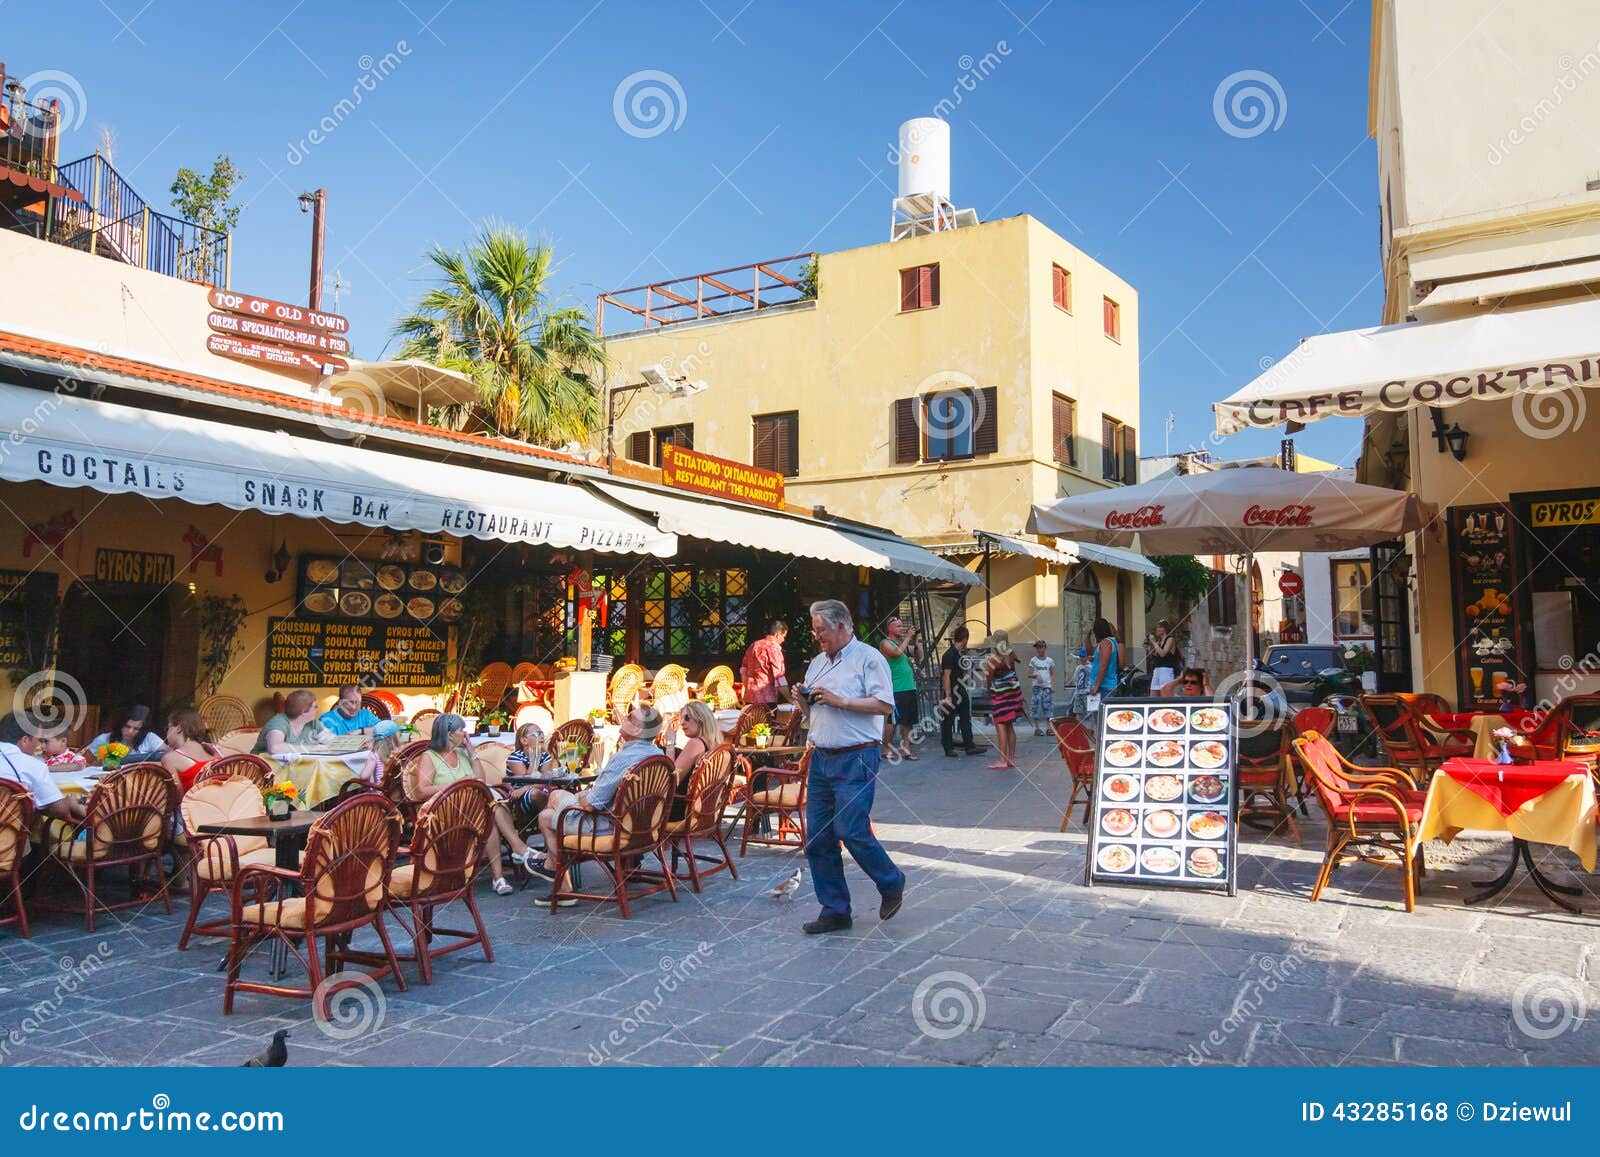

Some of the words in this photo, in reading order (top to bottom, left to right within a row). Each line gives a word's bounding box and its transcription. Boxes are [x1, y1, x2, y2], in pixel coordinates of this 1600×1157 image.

[215, 292, 243, 309] TOP
[250, 300, 269, 314] OF
[275, 306, 302, 320] OLD
[308, 313, 345, 331] TOWN
[209, 314, 238, 330] GREEK
[330, 340, 346, 351] FISH
[210, 341, 230, 352] ROOF
[232, 346, 261, 358] GARDEN
[1249, 390, 1363, 425] CAFE
[1379, 358, 1600, 409] COCKTAI
[675, 468, 727, 492] RESTAURANT
[38, 450, 184, 491] COCTAILS
[244, 480, 324, 512] SNACK
[352, 495, 390, 521] BAR
[441, 508, 553, 540] RESTAURANT
[1105, 503, 1166, 530] Coca-Cola
[1243, 503, 1315, 528] Coca-Cola
[1535, 502, 1595, 523] GYROS
[97, 550, 141, 583] GYROS
[144, 554, 173, 584] PITA
[273, 621, 321, 633] MOUSSAKA
[325, 623, 349, 635] PORK
[350, 625, 374, 637] CHOP
[386, 626, 413, 638] GYROS
[414, 627, 431, 638] PITA
[272, 634, 316, 646] YOUVETSI
[324, 636, 367, 648] SOUVLAKI
[415, 640, 446, 650] CHICKEN
[271, 647, 309, 658] STIFADO
[324, 649, 355, 660] PEPPER
[356, 650, 381, 661] STEAK
[270, 659, 310, 671] GEMISTA
[323, 661, 352, 673] GYROS
[353, 662, 379, 673] PLATE
[269, 672, 317, 684] SPAGHETTI
[323, 673, 360, 685] TZATZIKI
[383, 674, 409, 685] FILLET
[410, 675, 441, 685] MIGNON
